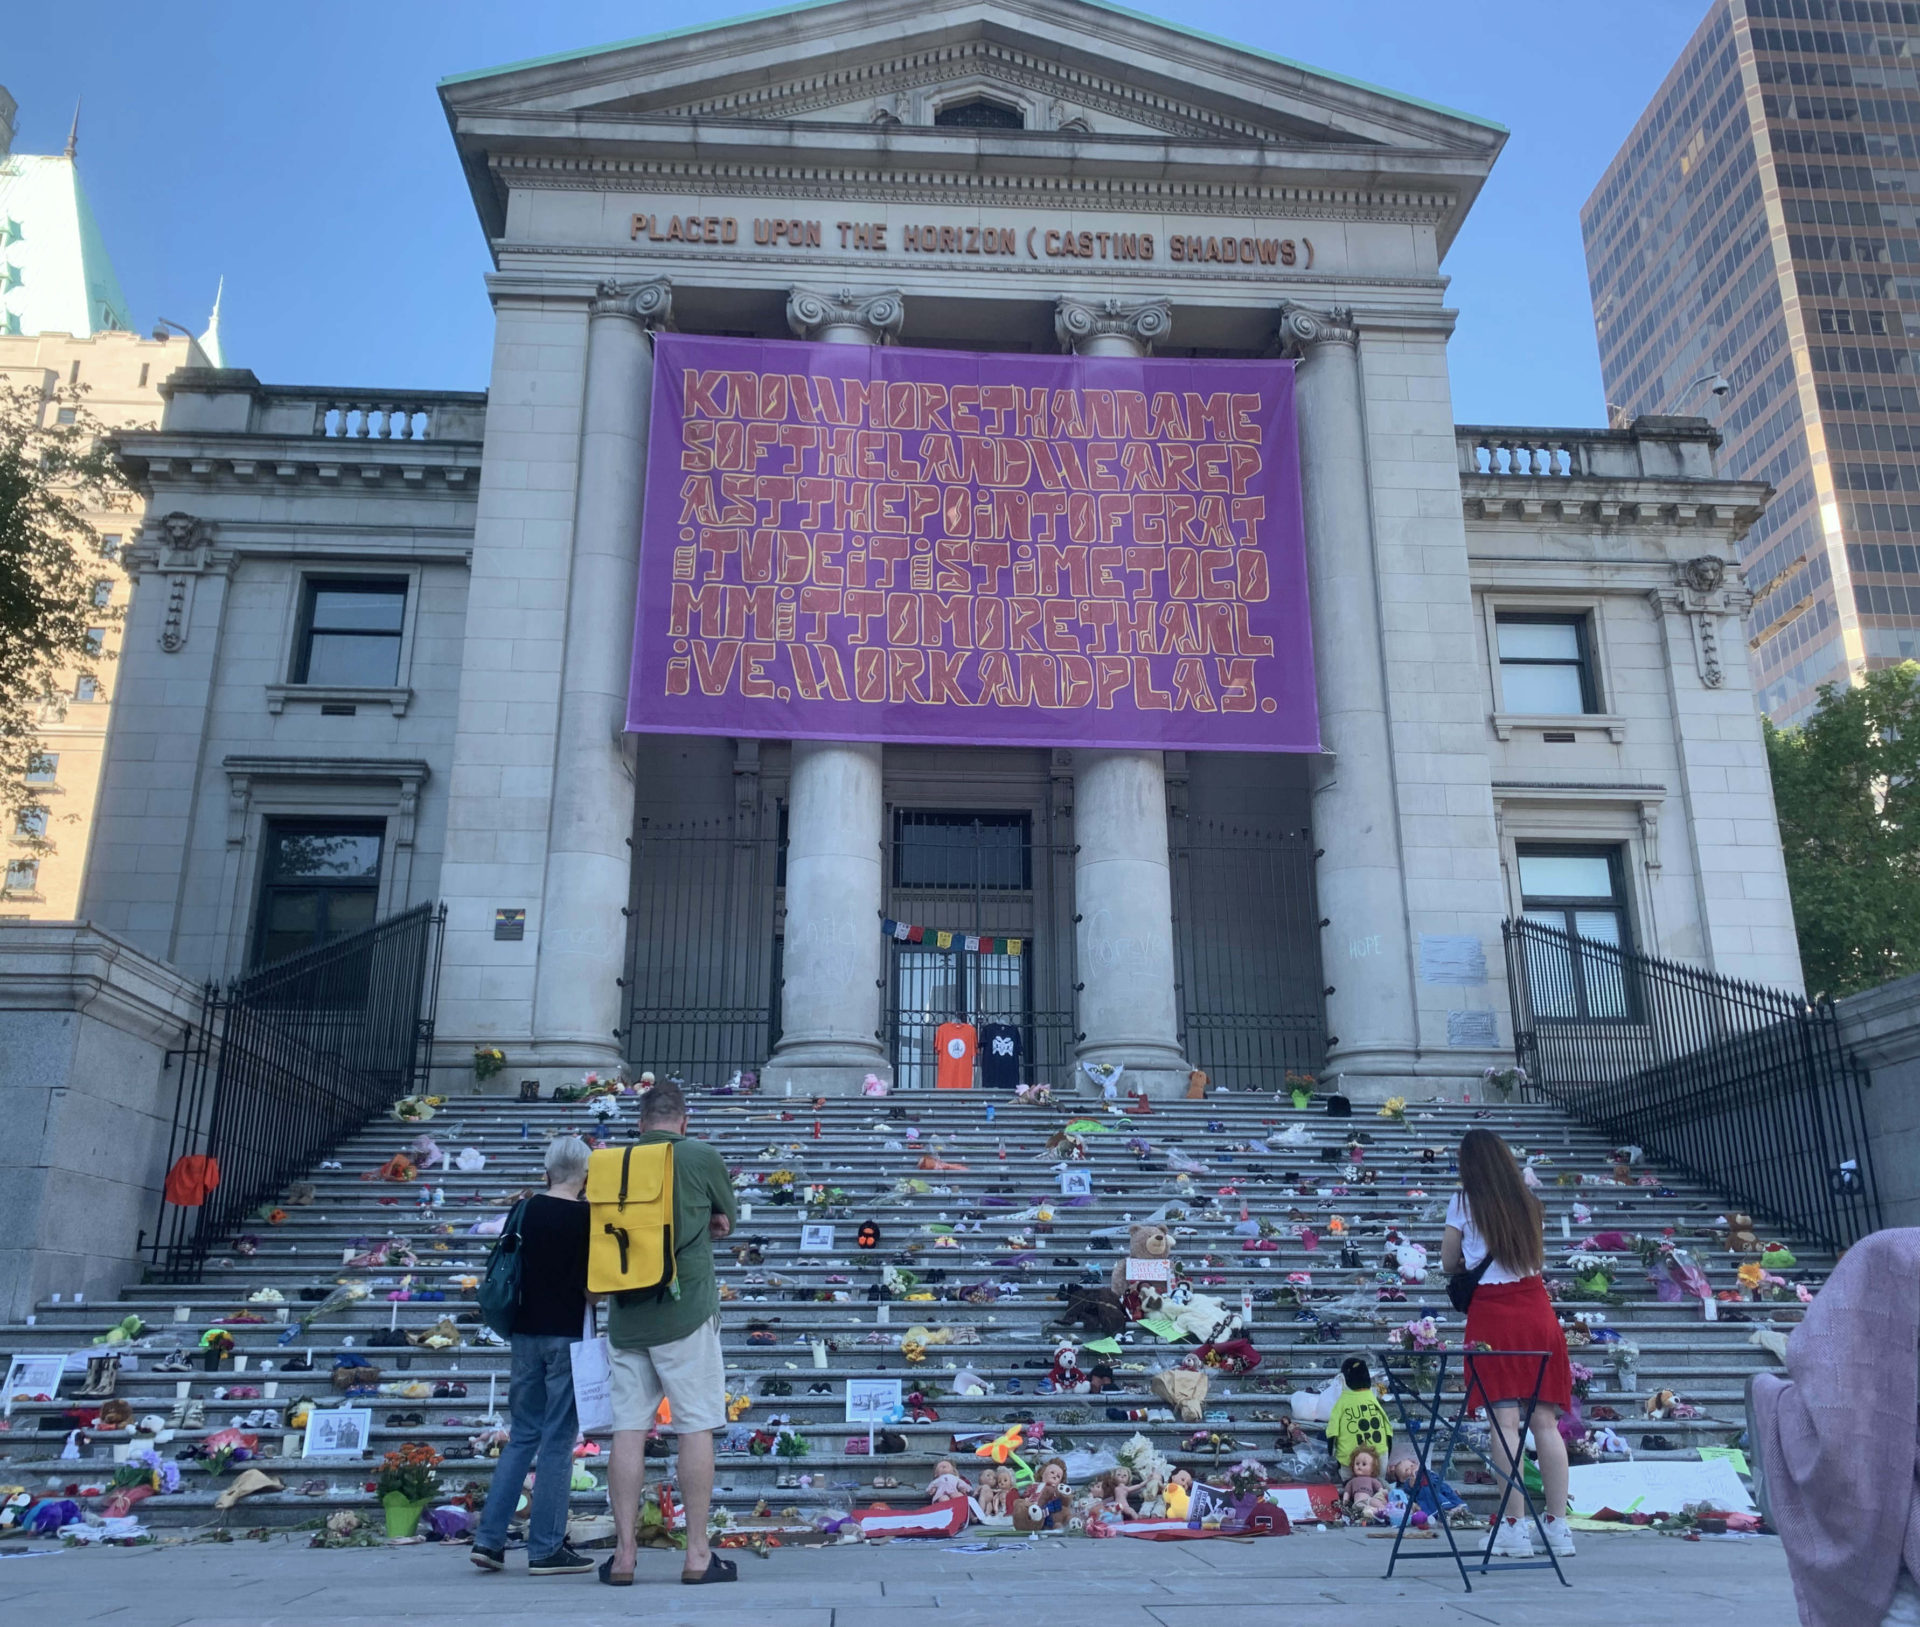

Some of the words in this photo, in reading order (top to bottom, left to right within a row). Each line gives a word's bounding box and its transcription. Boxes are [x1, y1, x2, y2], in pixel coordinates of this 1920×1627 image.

[631, 213, 738, 244] PLACED
[754, 219, 821, 248] UPON
[837, 222, 887, 250] THE
[904, 224, 1015, 254] HORIZON
[1027, 227, 1155, 261] (CASTING
[1170, 235, 1315, 270] SHADOWS)
[1350, 935, 1381, 960] HOPE
[1347, 1416, 1384, 1434] COOL
[1356, 1430, 1382, 1446] BRO
